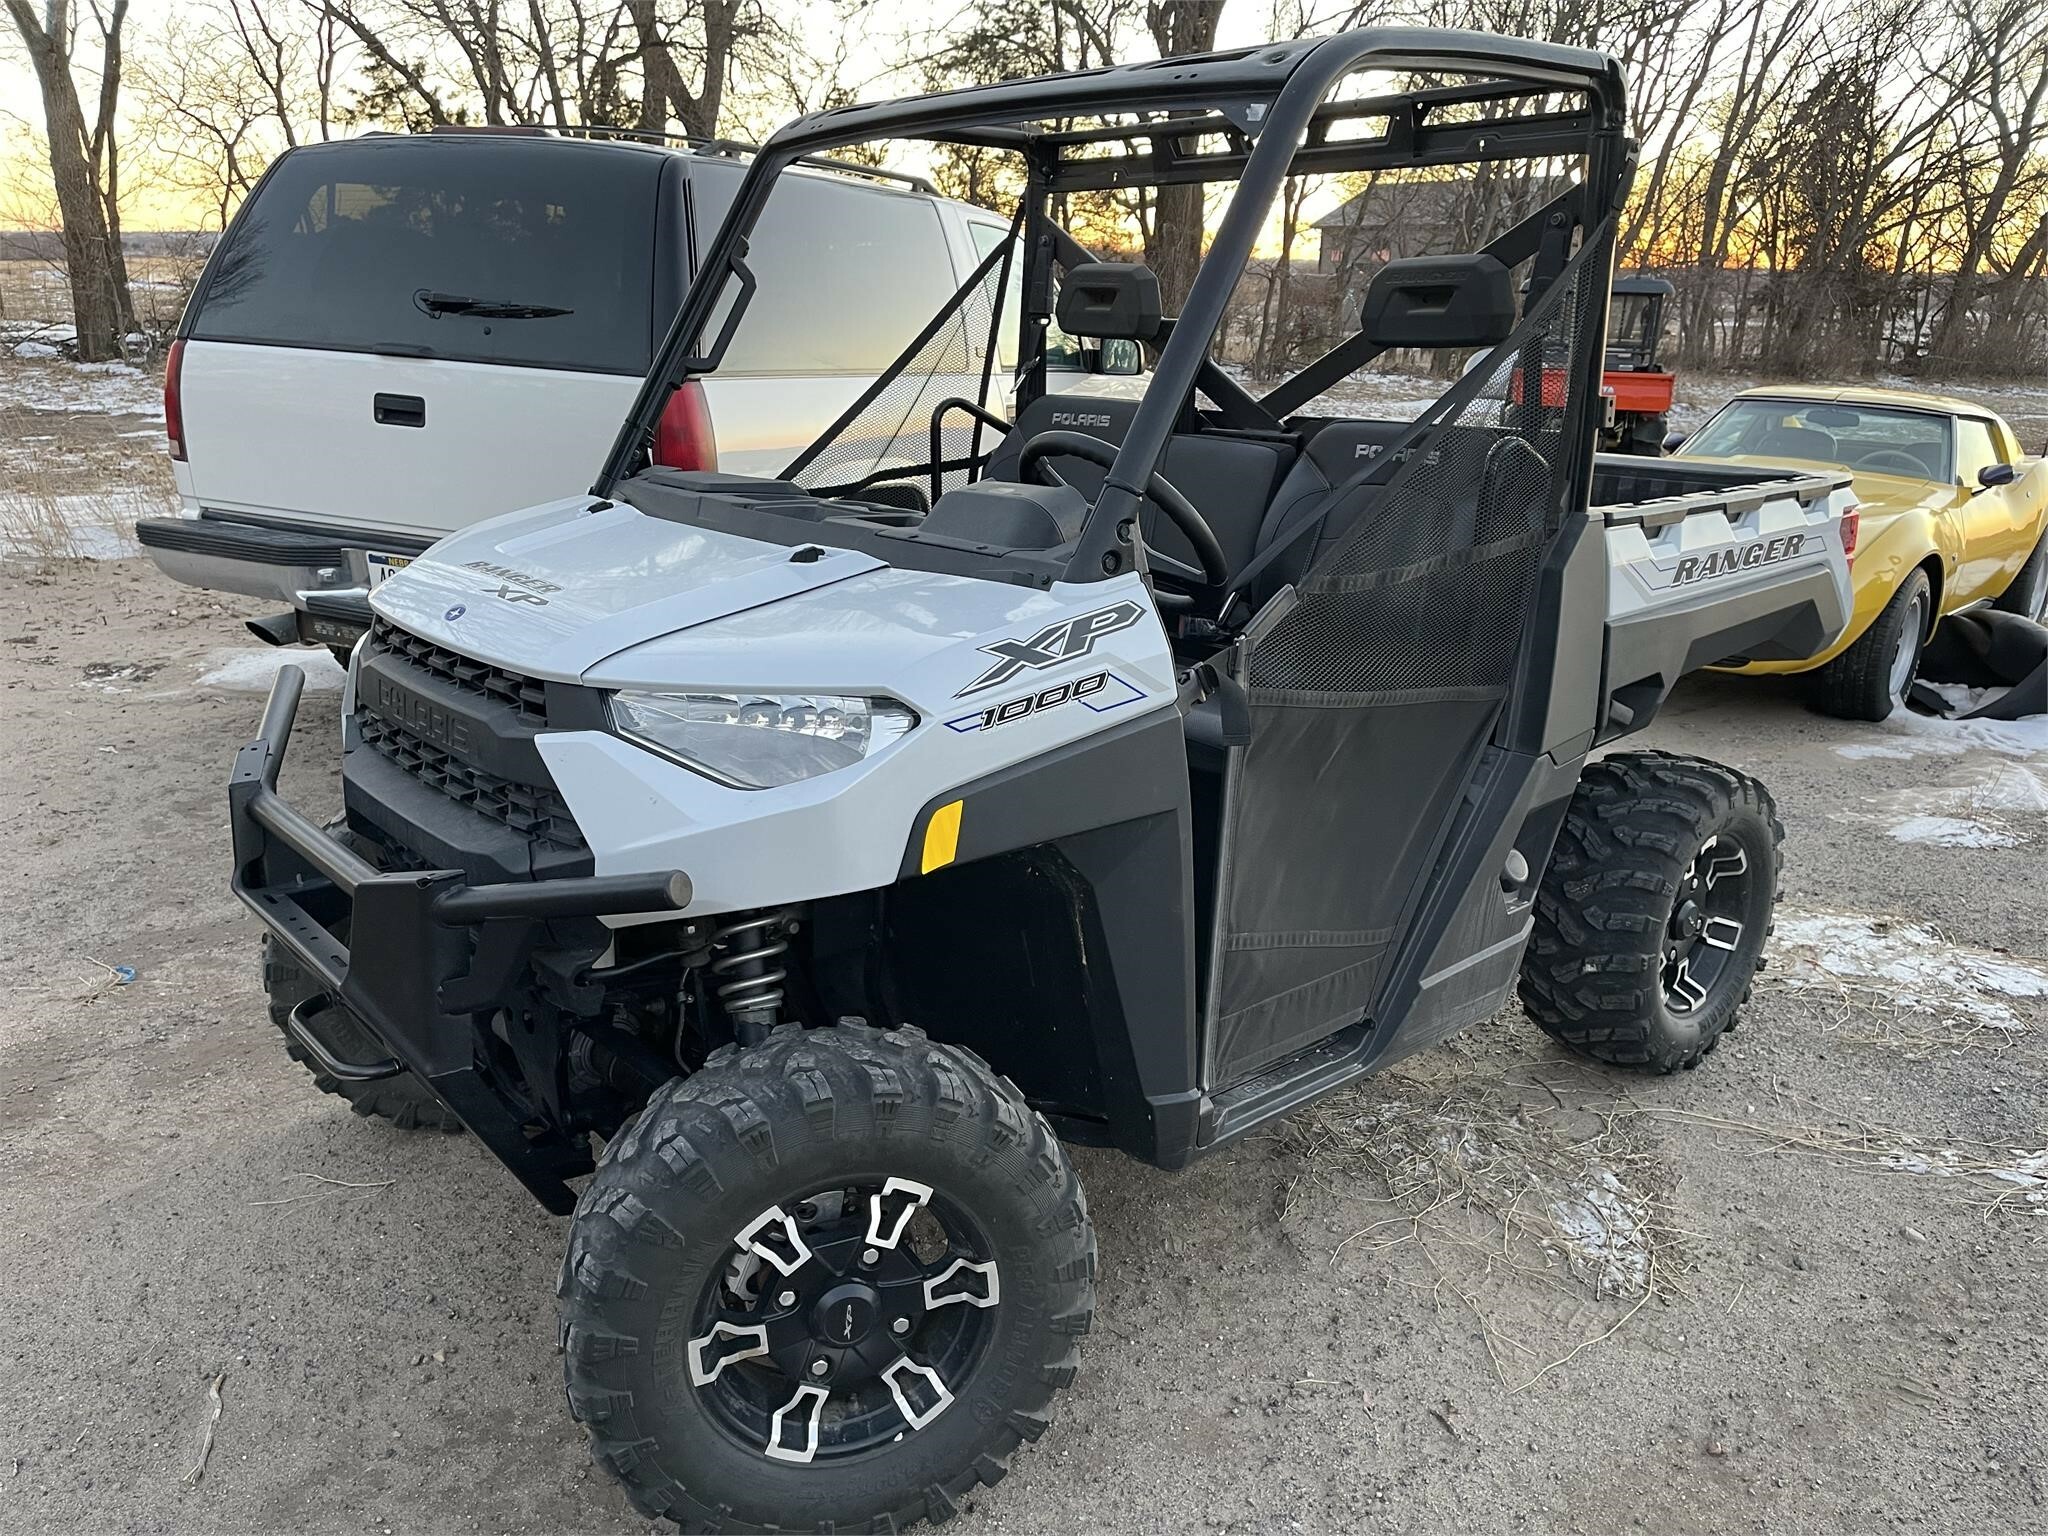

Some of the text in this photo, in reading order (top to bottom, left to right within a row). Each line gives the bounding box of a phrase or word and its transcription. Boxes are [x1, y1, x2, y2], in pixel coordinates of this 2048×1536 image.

[1051, 412, 1111, 427] POLARIS
[460, 559, 565, 595] RANGER
[1670, 532, 1806, 588] RANGER
[479, 583, 550, 606] XP
[950, 598, 1148, 700] XP
[377, 677, 472, 756] POLARIS
[978, 668, 1109, 731] 1000
[843, 1304, 853, 1340] XP
